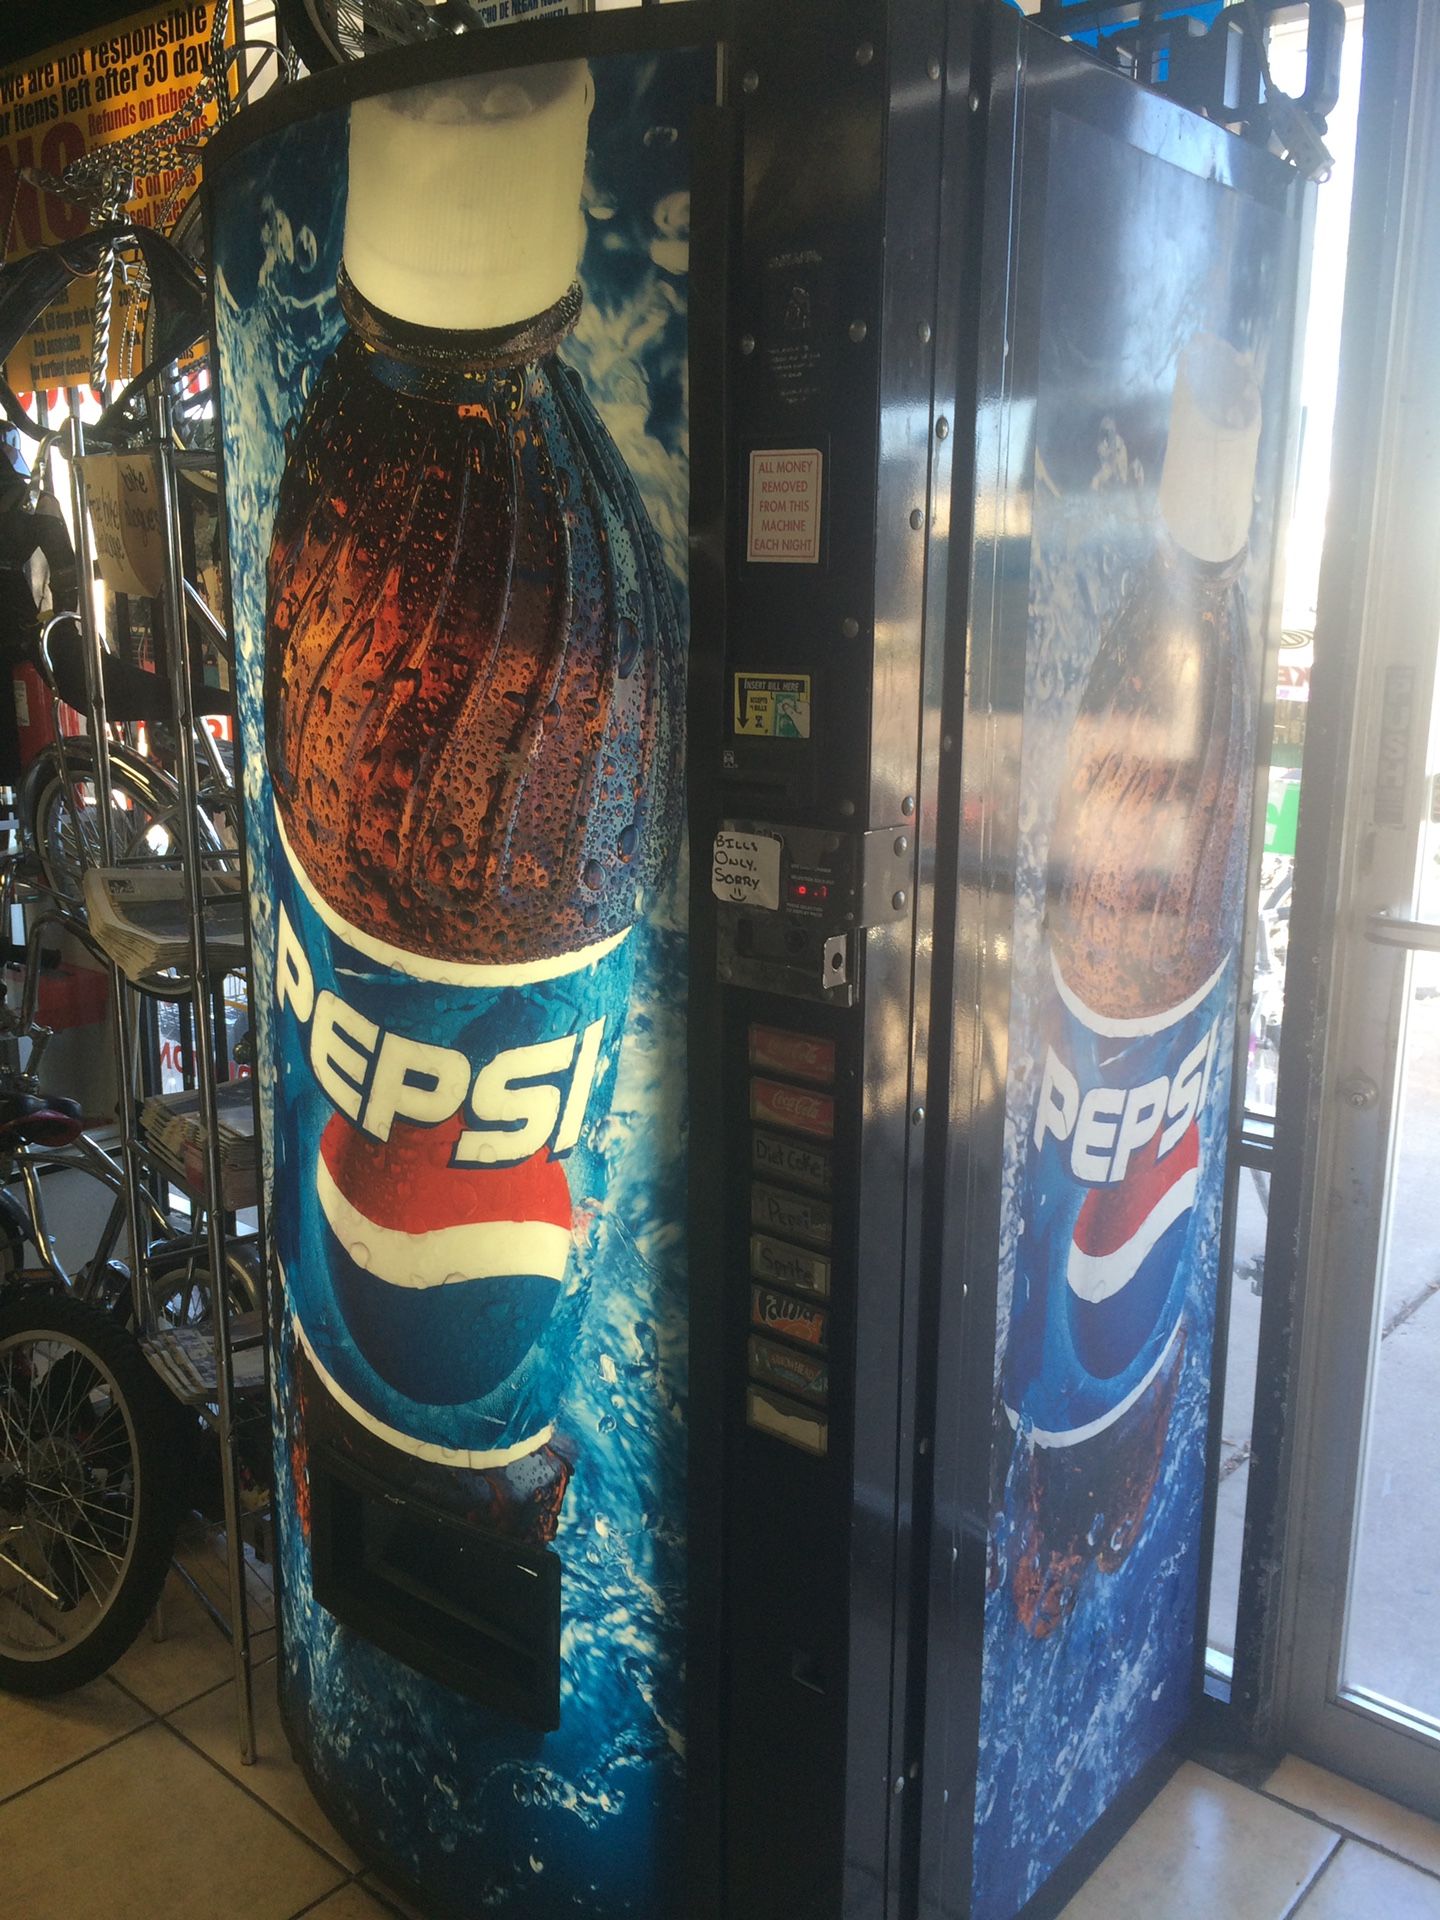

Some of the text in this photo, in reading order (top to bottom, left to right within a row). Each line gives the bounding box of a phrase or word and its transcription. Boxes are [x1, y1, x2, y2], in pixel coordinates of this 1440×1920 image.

[499, 1, 509, 20] DE
[27, 61, 55, 95] are
[57, 48, 86, 84] not
[89, 5, 207, 72] responsible
[13, 94, 60, 131] items
[61, 77, 92, 116] left
[94, 62, 140, 103] after
[142, 49, 169, 88] 30
[172, 41, 214, 78] day
[87, 101, 137, 137] Refunds
[138, 98, 155, 122] on
[145, 174, 161, 197] on
[130, 201, 152, 227] sed
[758, 458, 814, 474] ALL MONEY
[761, 480, 809, 494] REMOVED
[759, 499, 810, 513] FROM THIS
[761, 519, 807, 533] MACHINE
[754, 538, 813, 552] EACH NIGHT
[277, 900, 607, 1164] PEPSI
[1034, 1016, 1220, 1183] PEPSI
[756, 1139, 785, 1167] Diet
